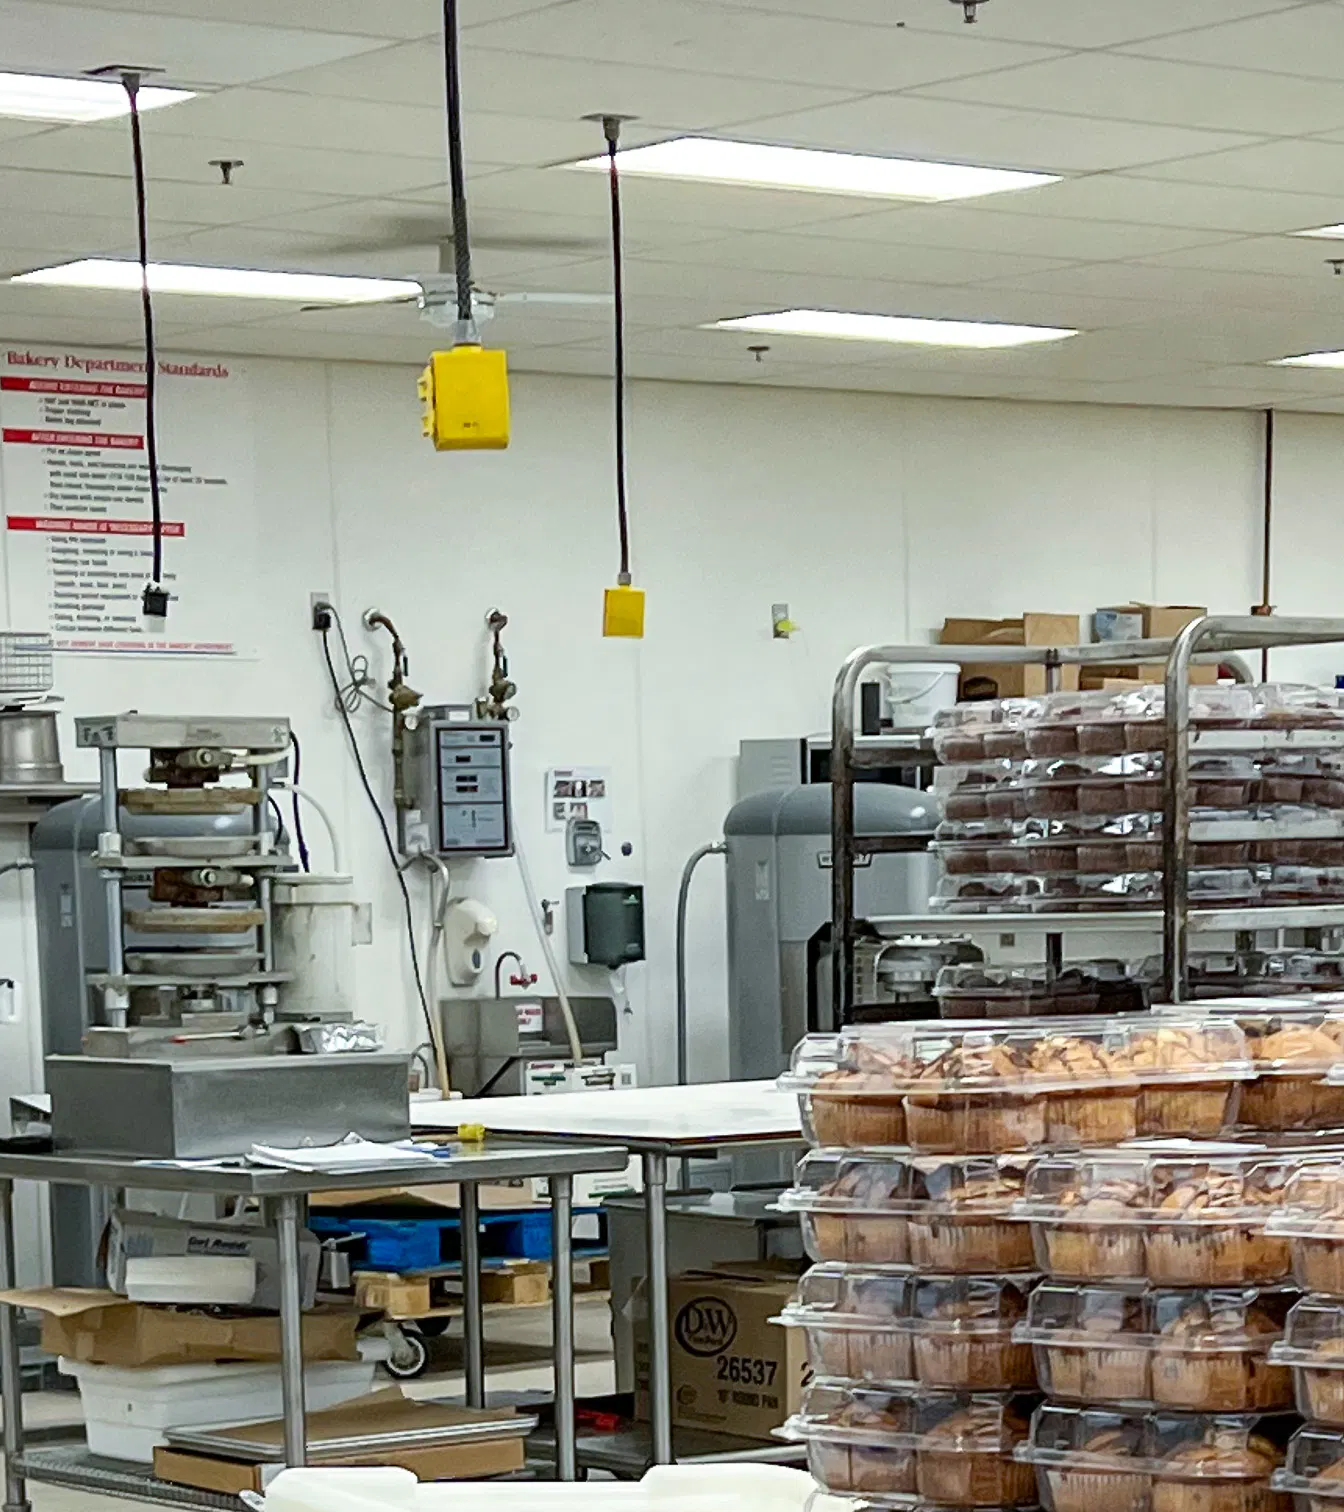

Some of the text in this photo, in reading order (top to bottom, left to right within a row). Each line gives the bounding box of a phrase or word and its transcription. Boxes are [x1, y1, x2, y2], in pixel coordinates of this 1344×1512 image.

[7, 351, 59, 370] Bakery
[65, 354, 149, 374] Departmen
[716, 1355, 777, 1387] 26537
